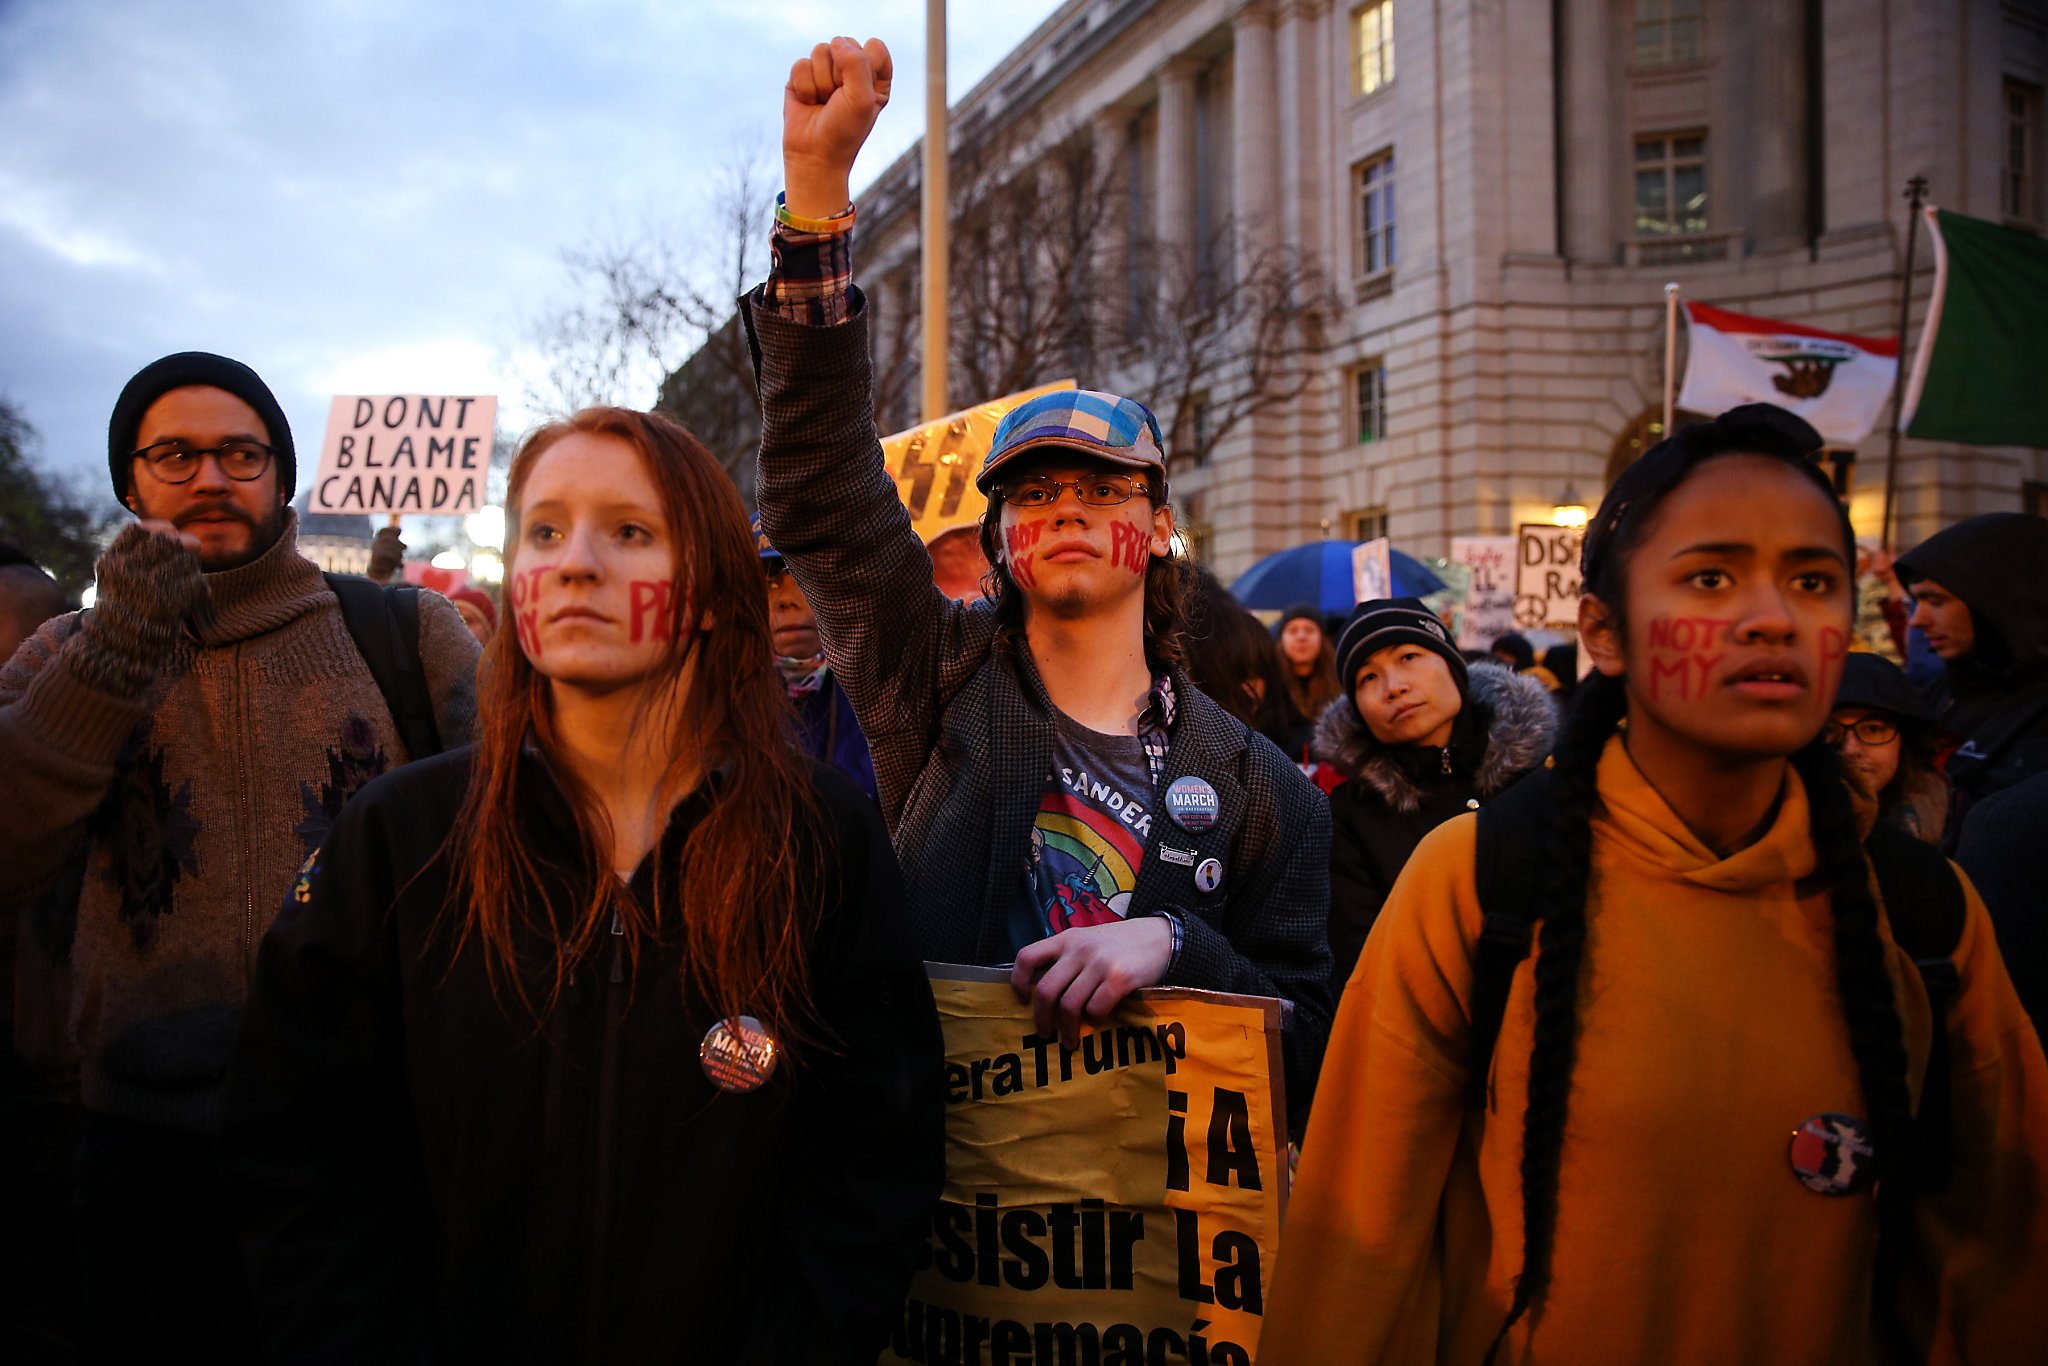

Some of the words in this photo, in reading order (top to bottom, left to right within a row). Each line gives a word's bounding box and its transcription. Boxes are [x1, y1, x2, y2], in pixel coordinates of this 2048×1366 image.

[354, 397, 474, 428] DONT
[336, 436, 479, 468] BLAME
[319, 476, 475, 508] CANADA
[1525, 534, 1578, 566] DIS
[1649, 618, 1731, 652] NOT
[1651, 654, 1726, 702] MY
[1172, 793, 1216, 807] MARCH
[1173, 784, 1213, 794] WOMEN'S
[918, 1192, 1145, 1291] sistir
[1173, 1206, 1264, 1317] La
